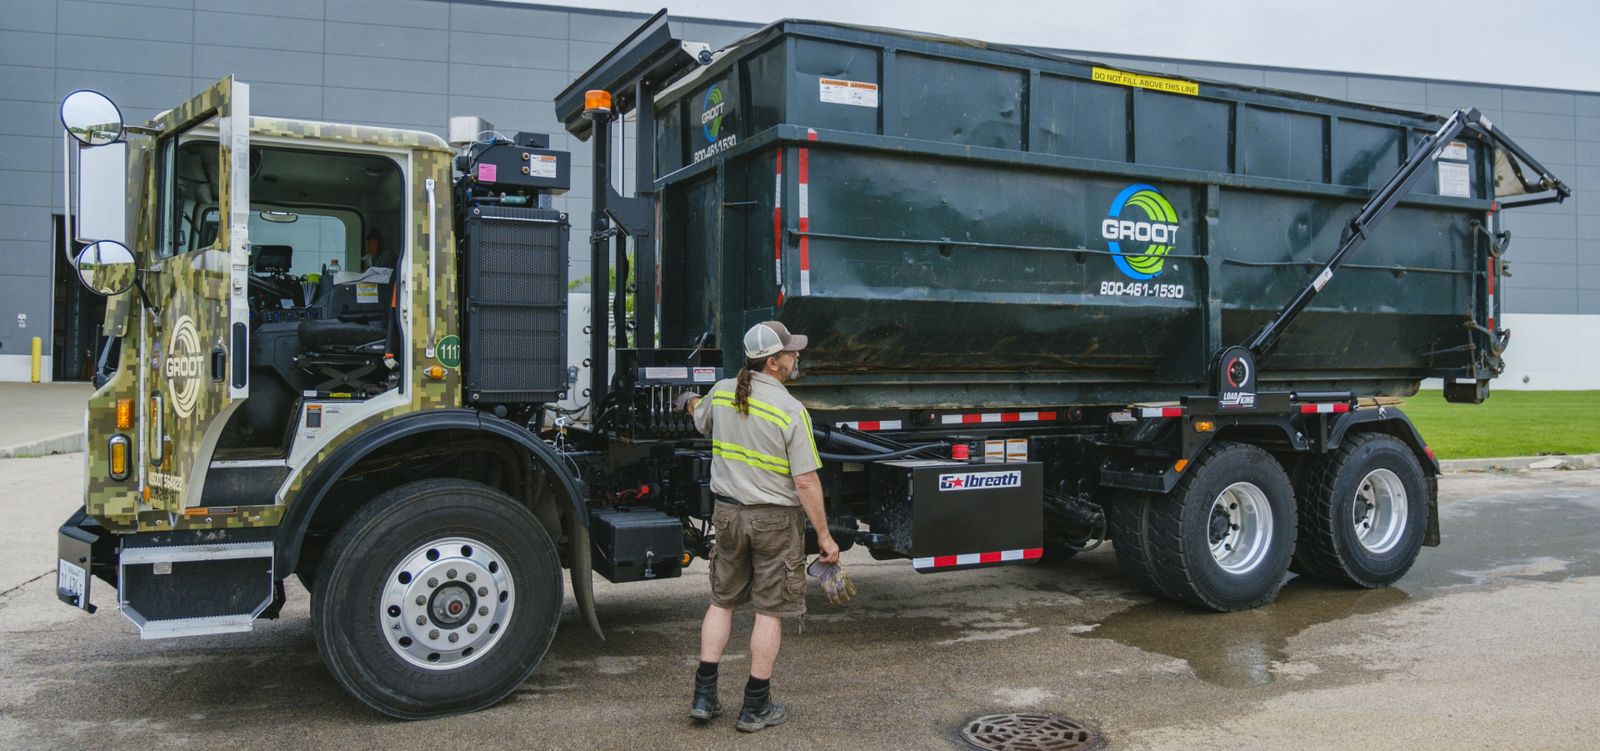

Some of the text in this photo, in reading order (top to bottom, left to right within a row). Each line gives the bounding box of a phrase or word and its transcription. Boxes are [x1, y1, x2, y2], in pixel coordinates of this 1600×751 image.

[1094, 72, 1197, 94] DO NOT FILL ABOVE THIS LINE
[701, 102, 724, 124] GROOT
[1102, 219, 1180, 244] GROOT
[1100, 281, 1184, 298] 800-461-1530
[166, 356, 204, 377] GROOT
[1223, 392, 1239, 401] LOAD
[1240, 396, 1254, 404] KING
